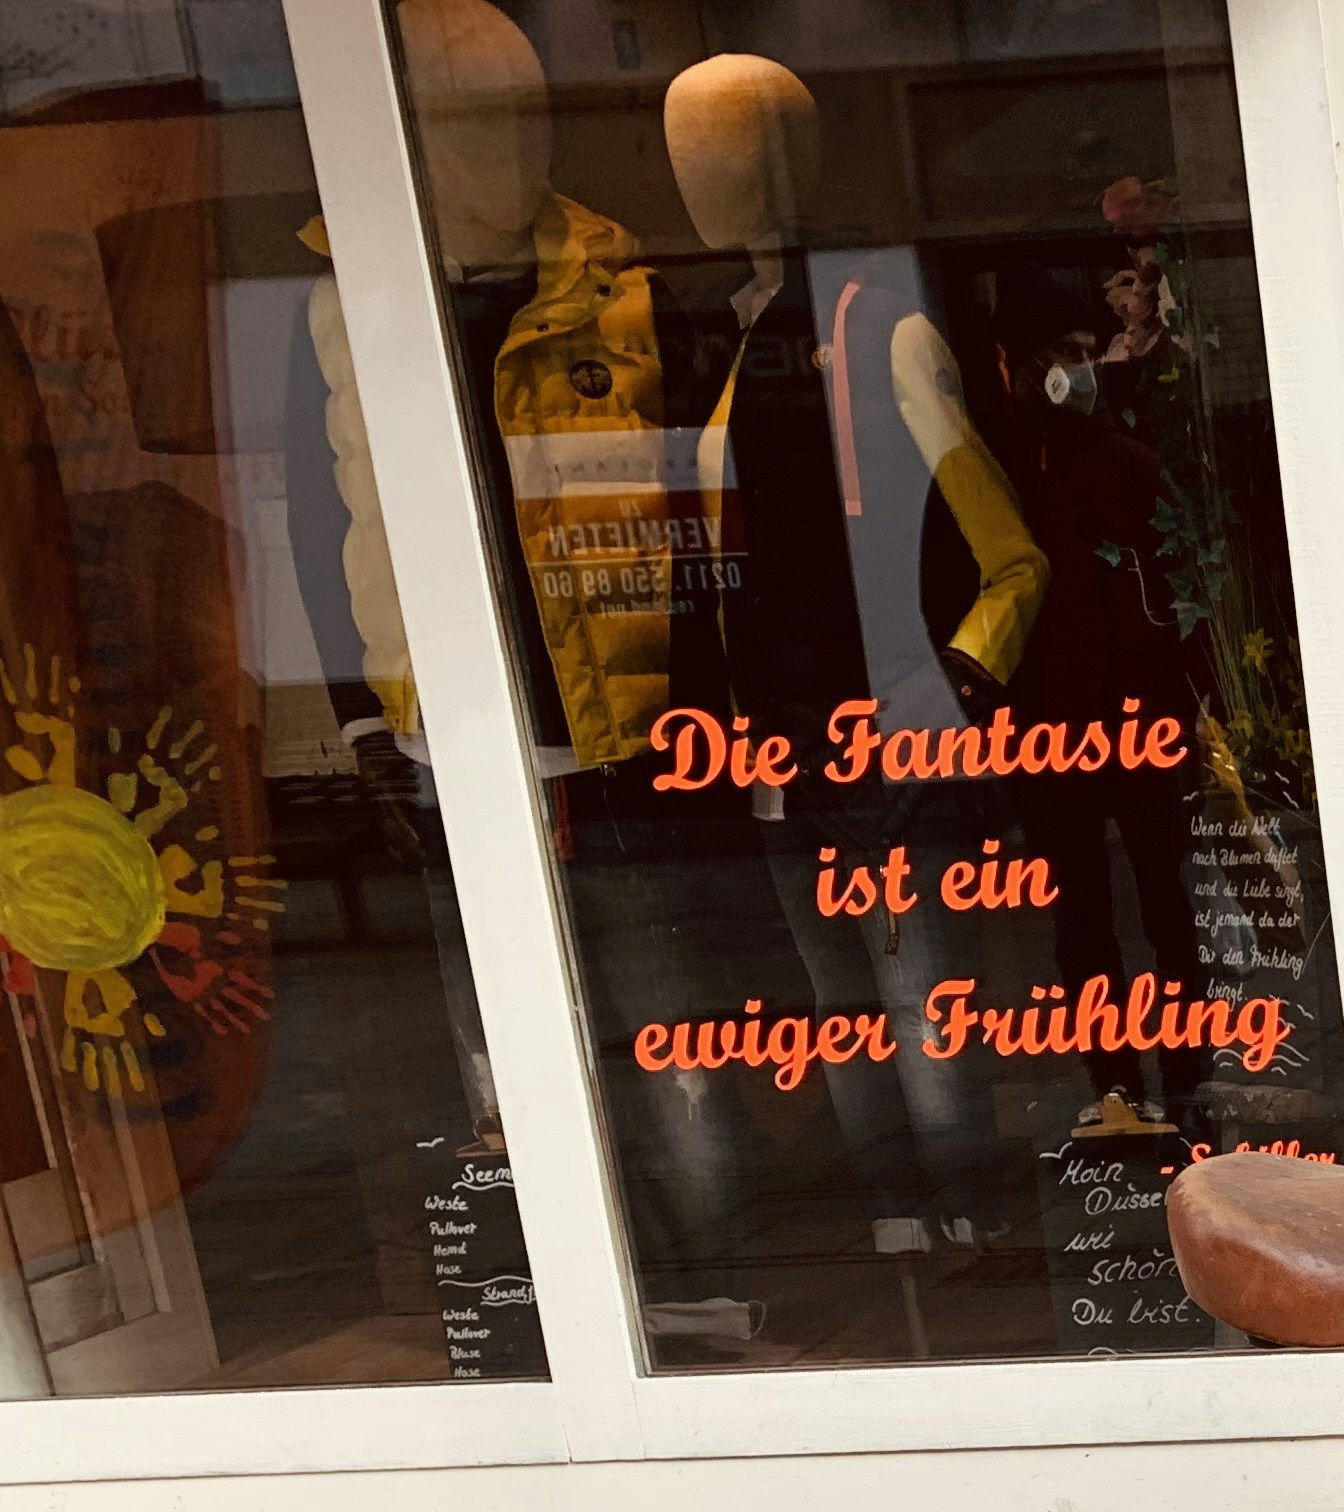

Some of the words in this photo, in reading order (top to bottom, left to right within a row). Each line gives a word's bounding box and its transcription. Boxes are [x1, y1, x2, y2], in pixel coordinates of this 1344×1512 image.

[649, 707, 799, 792] Die
[824, 697, 1188, 783] Fantasie
[1190, 815, 1223, 836] Wenn
[1192, 848, 1217, 866] nach
[1219, 848, 1261, 867] Blumen
[1263, 846, 1298, 872] duftet
[816, 845, 918, 917] ist
[941, 838, 1059, 911] ein
[1194, 879, 1217, 897] und
[1242, 877, 1272, 898] Liebe
[1194, 908, 1212, 929] ist
[1210, 910, 1255, 938] jemand
[1258, 910, 1275, 928] da
[1277, 910, 1301, 928] der
[1221, 947, 1245, 966] den
[633, 999, 897, 1091] ewiger
[923, 972, 1293, 1071] Frühling
[1058, 1158, 1124, 1186] Moin
[424, 1194, 469, 1211] Weste
[1085, 1182, 1168, 1216] Düsse
[429, 1221, 478, 1236] Pullover
[433, 1241, 468, 1257] Hemd
[435, 1263, 463, 1276] Hose
[442, 1307, 480, 1321] Weste
[1071, 1297, 1114, 1326] Du
[1126, 1297, 1201, 1325] bist.
[446, 1326, 491, 1340] Pullover
[449, 1345, 481, 1360] Bluse
[453, 1365, 481, 1378] Hose
